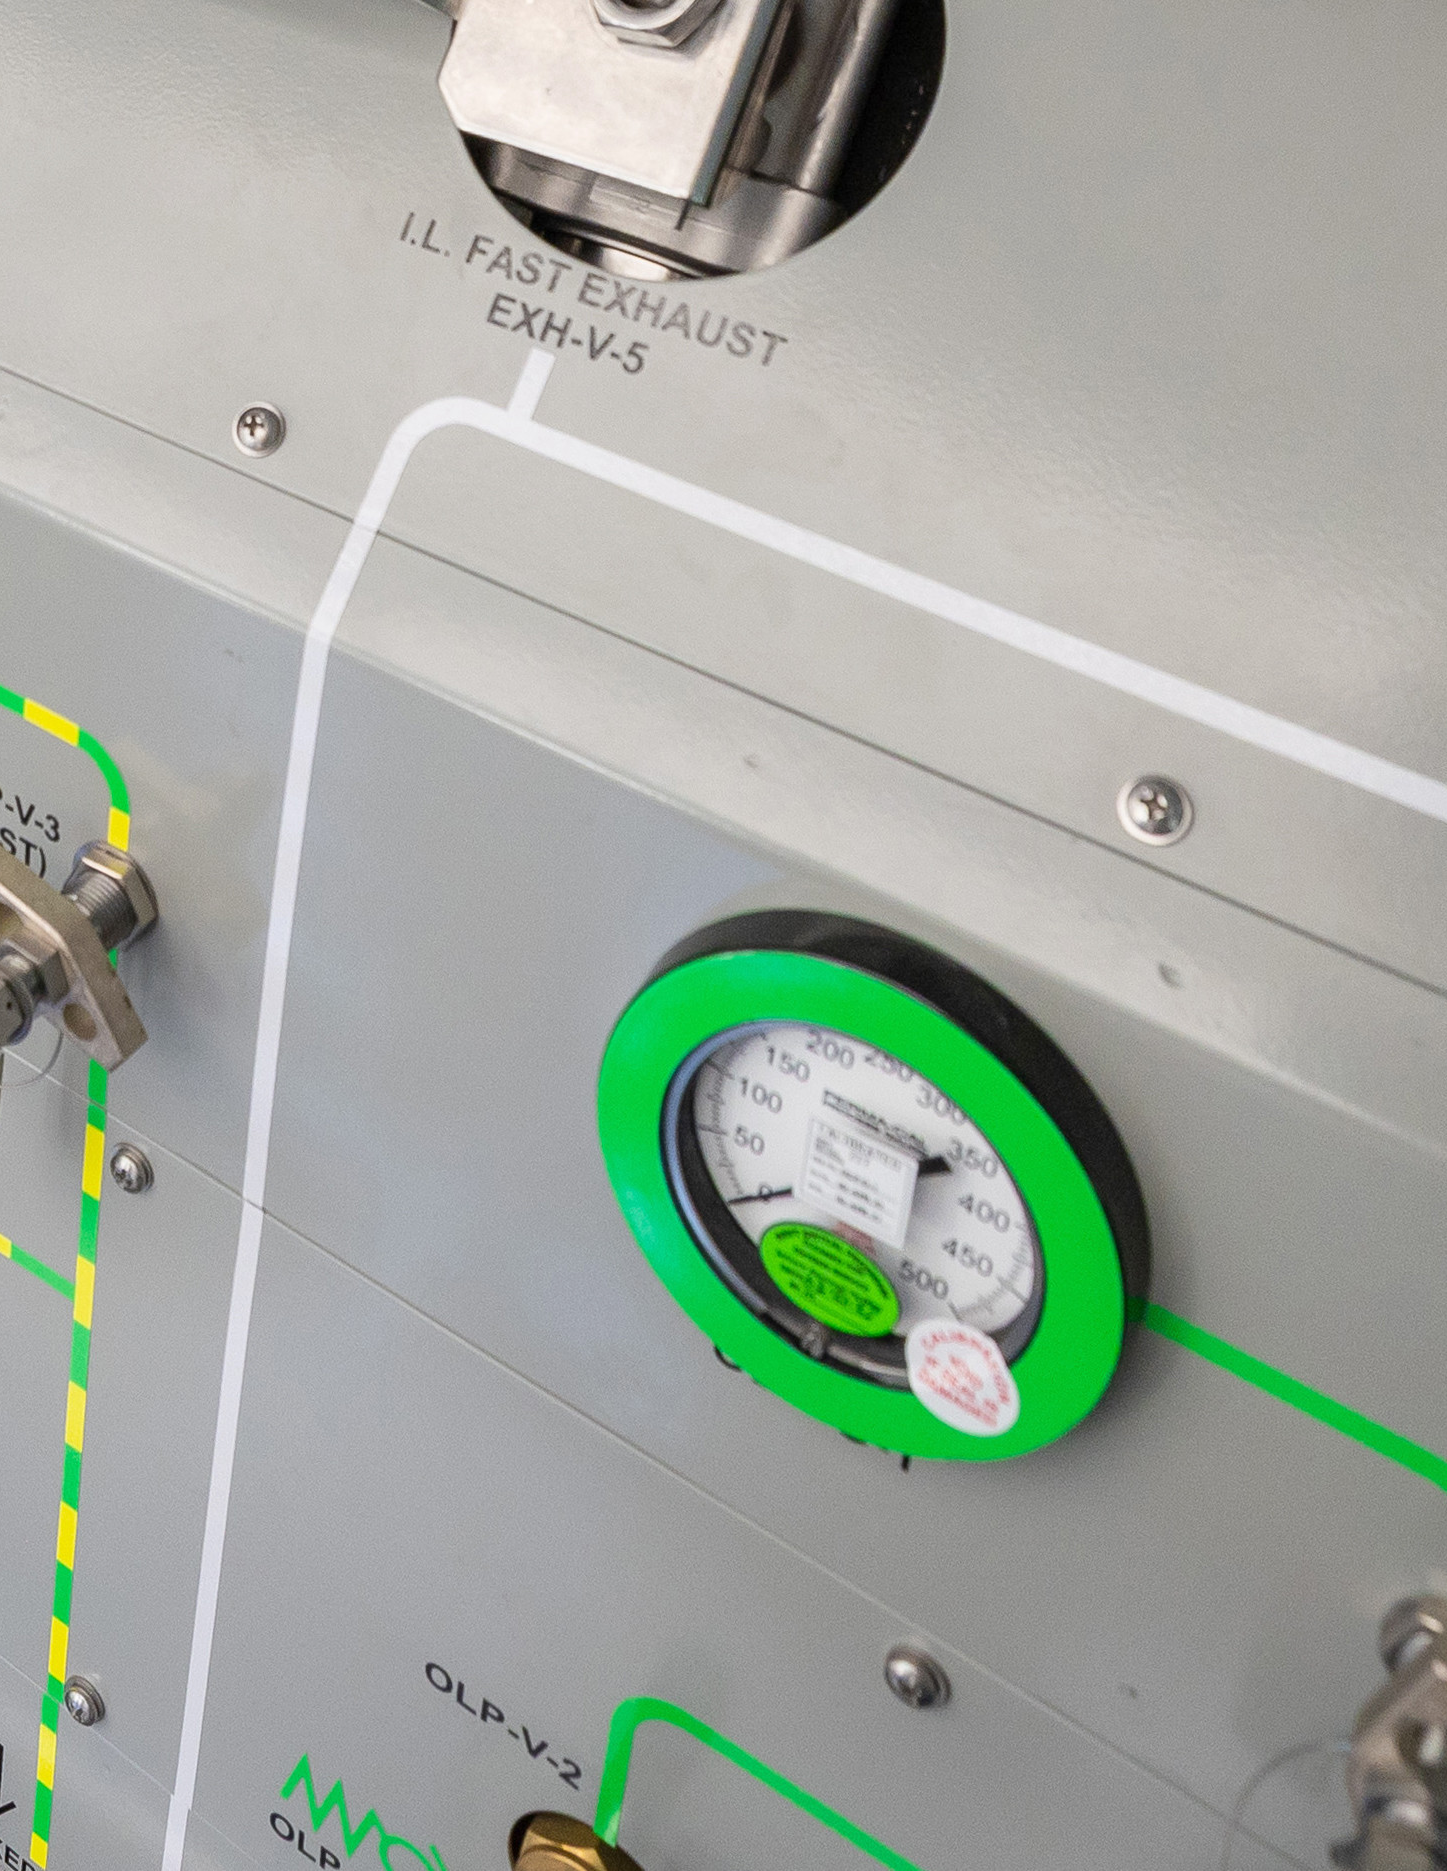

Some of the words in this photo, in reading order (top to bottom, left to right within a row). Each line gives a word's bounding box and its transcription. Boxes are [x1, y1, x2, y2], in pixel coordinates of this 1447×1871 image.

[400, 211, 450, 258] I.L.
[465, 234, 573, 295] FAST
[578, 273, 789, 368] EXHAUST
[486, 293, 650, 376] EXH-V-5
[766, 1046, 810, 1082] 150
[806, 1031, 855, 1071] 200
[739, 1079, 783, 1114] 100
[915, 1084, 968, 1126] 300
[734, 1126, 765, 1156] 50
[949, 1137, 999, 1179] 350
[957, 1193, 1011, 1232] 400
[942, 1239, 994, 1278] 450
[899, 1259, 950, 1301] 500
[424, 1661, 583, 1791] OLP-V-2
